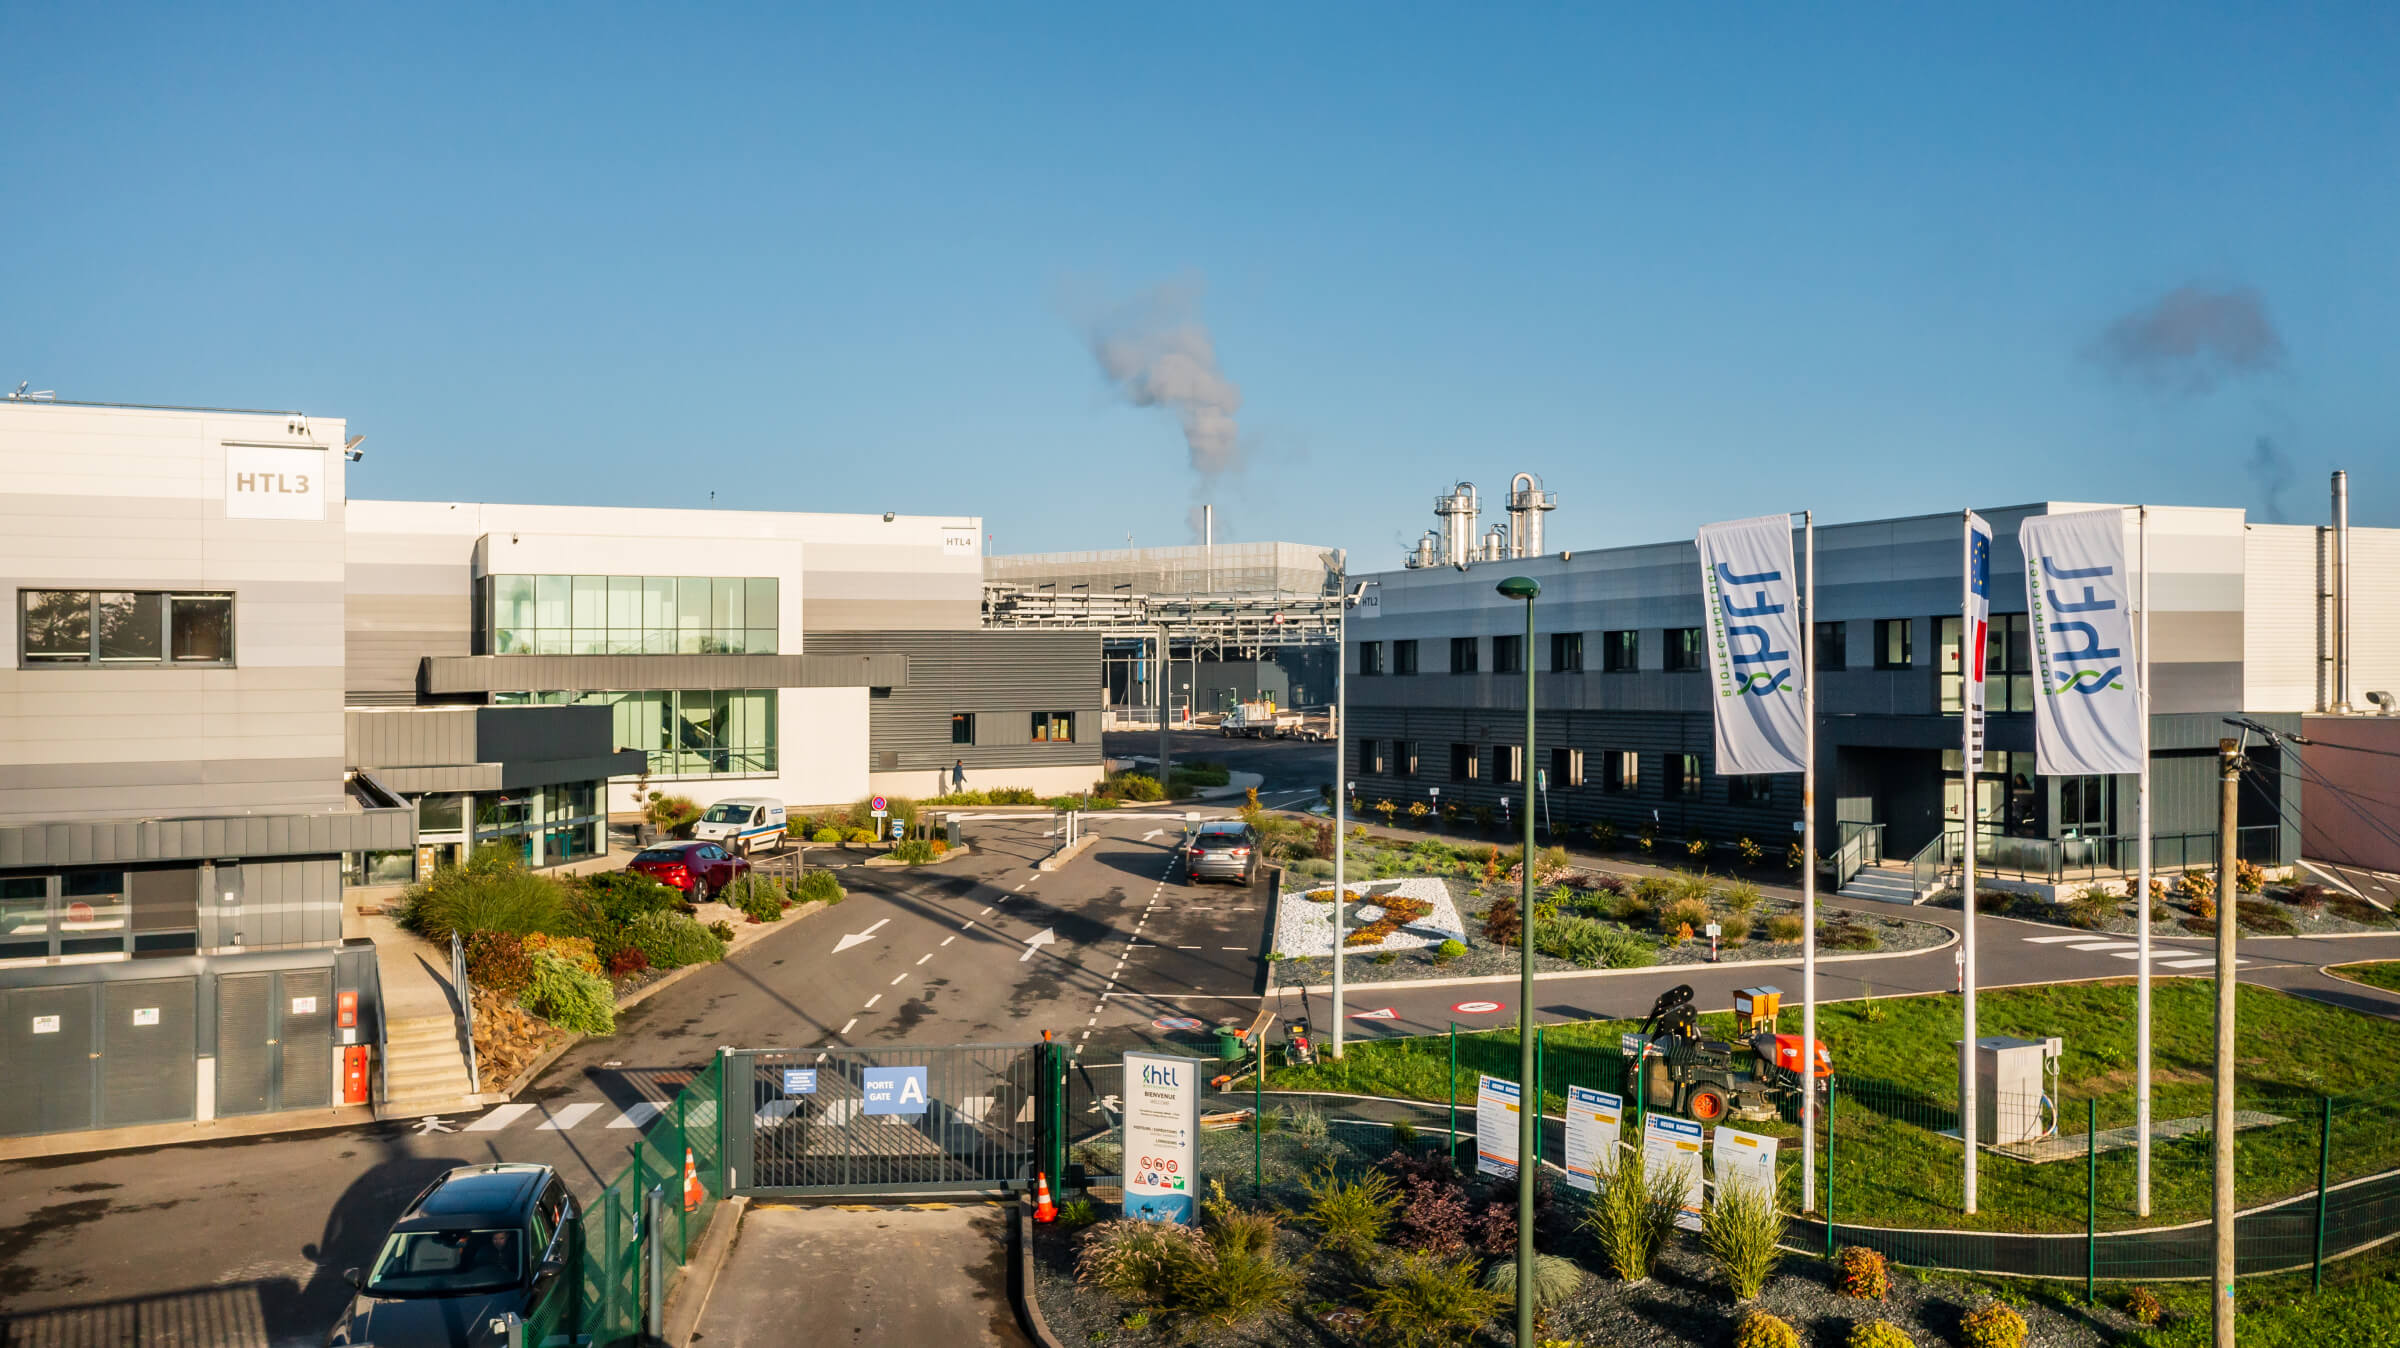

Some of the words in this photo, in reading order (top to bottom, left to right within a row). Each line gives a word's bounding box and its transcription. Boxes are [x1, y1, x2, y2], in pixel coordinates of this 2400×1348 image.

[237, 472, 309, 494] HTL3
[946, 537, 971, 546] HTL4
[1362, 596, 1378, 607] HTL2
[1151, 1064, 1179, 1087] htl
[866, 1081, 894, 1090] PORTE
[899, 1076, 924, 1104] A
[869, 1092, 891, 1101] GATE
[1144, 1090, 1176, 1100] BIENVENUE
